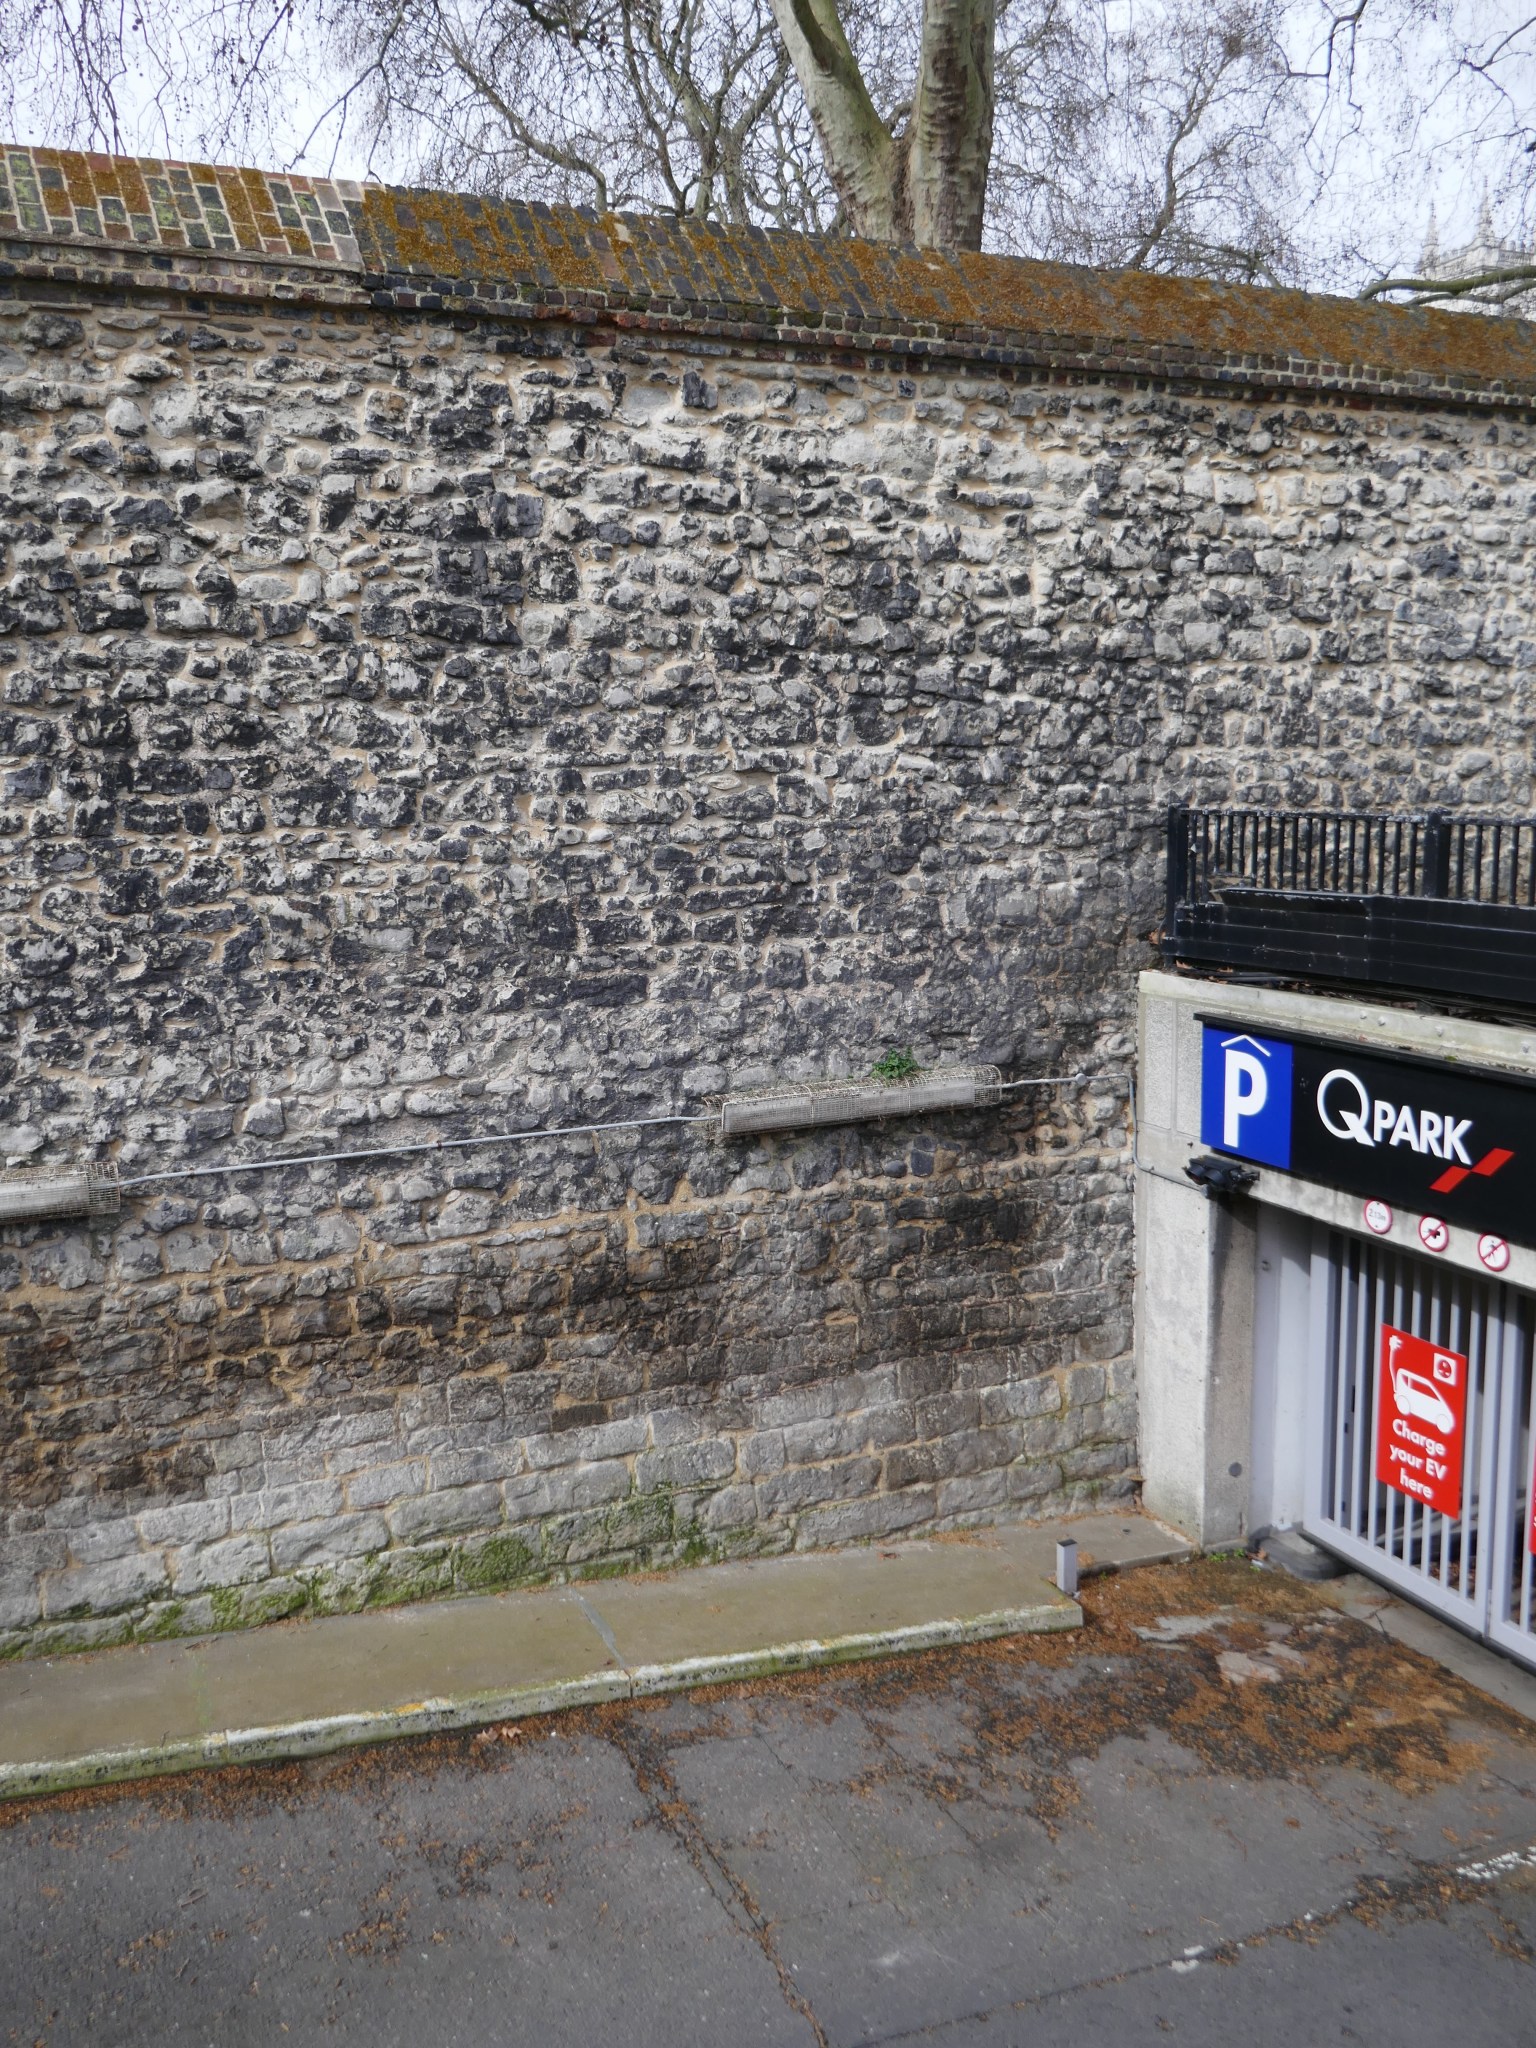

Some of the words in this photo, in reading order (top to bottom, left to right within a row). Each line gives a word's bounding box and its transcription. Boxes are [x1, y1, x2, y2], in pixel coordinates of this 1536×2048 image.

[1223, 1048, 1268, 1148] P
[1392, 1418, 1446, 1456] Charge
[1390, 1443, 1424, 1469] your
[1426, 1459, 1448, 1480] EV
[1400, 1467, 1434, 1499] here
